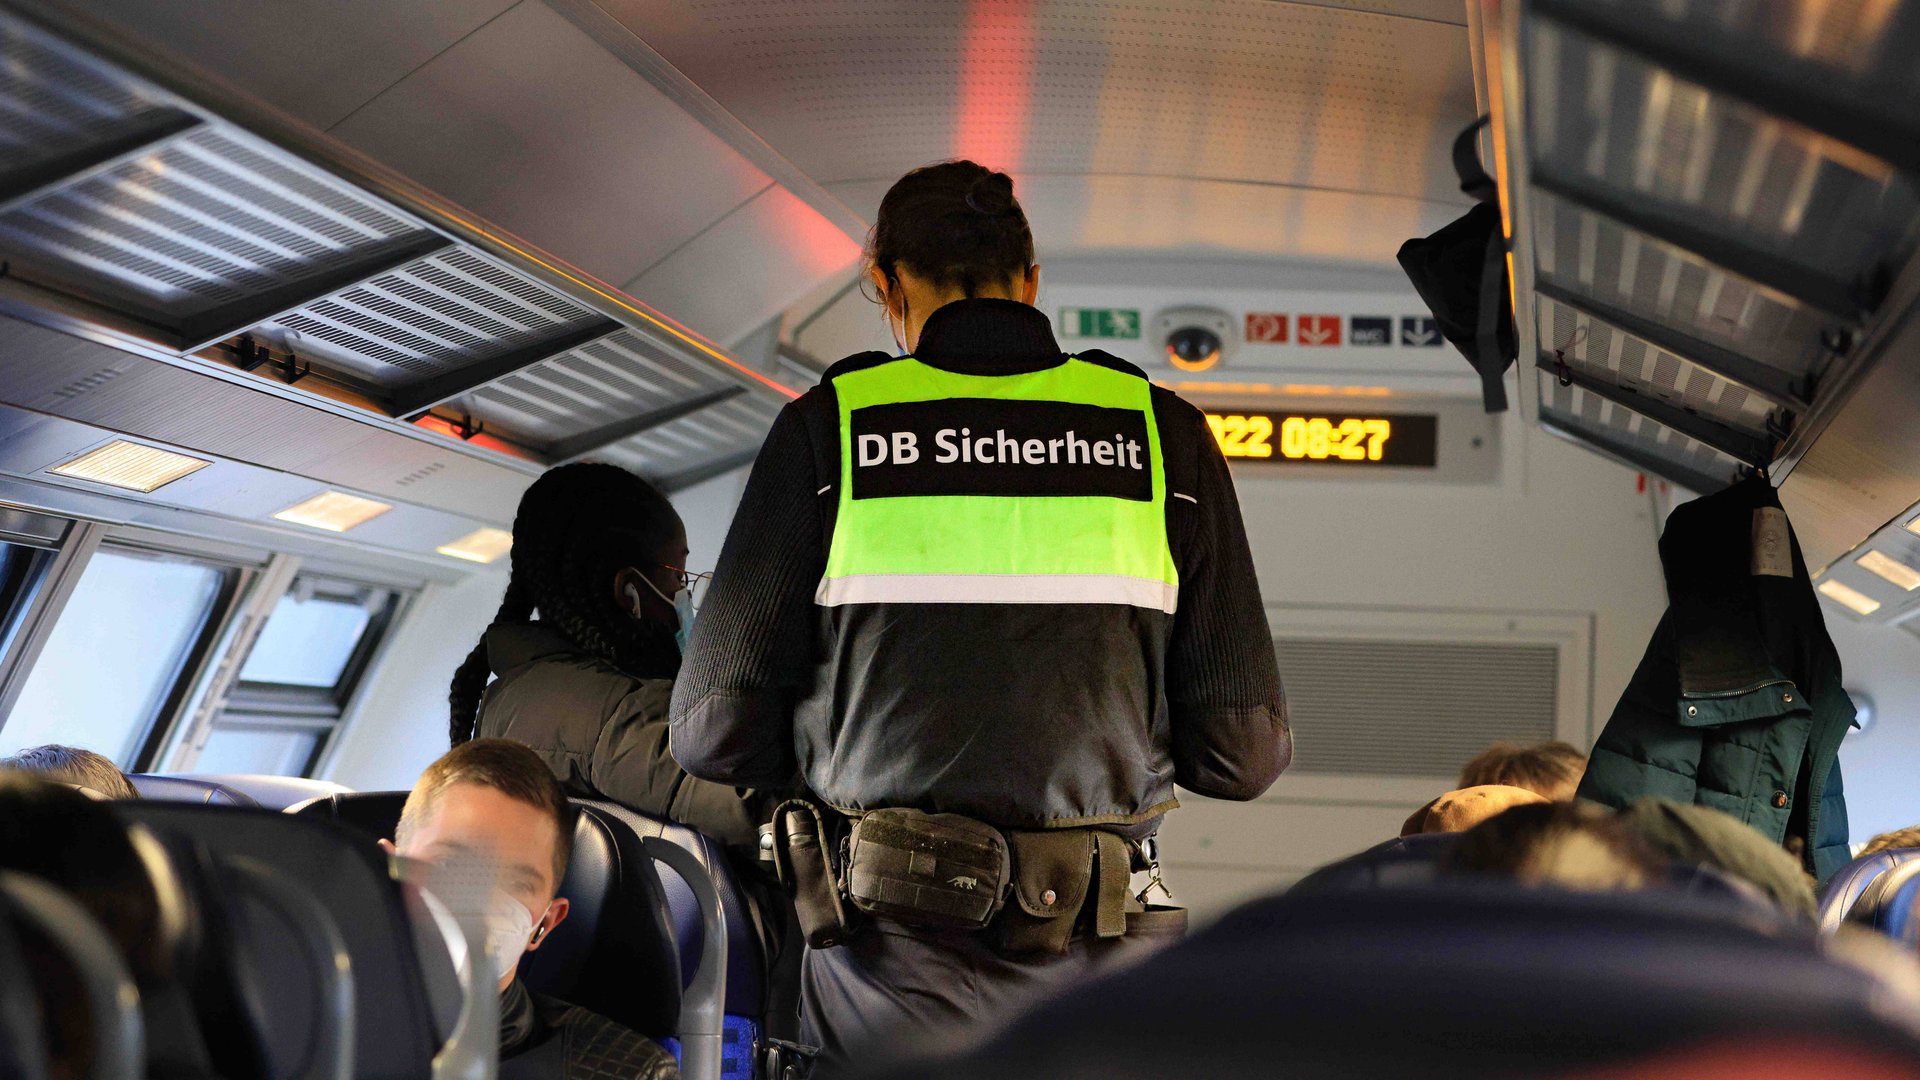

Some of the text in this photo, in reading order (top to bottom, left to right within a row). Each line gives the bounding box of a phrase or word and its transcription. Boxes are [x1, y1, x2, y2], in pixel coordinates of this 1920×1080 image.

[857, 427, 1143, 470] DB Sicherheit
[1281, 417, 1391, 461] 08:27
